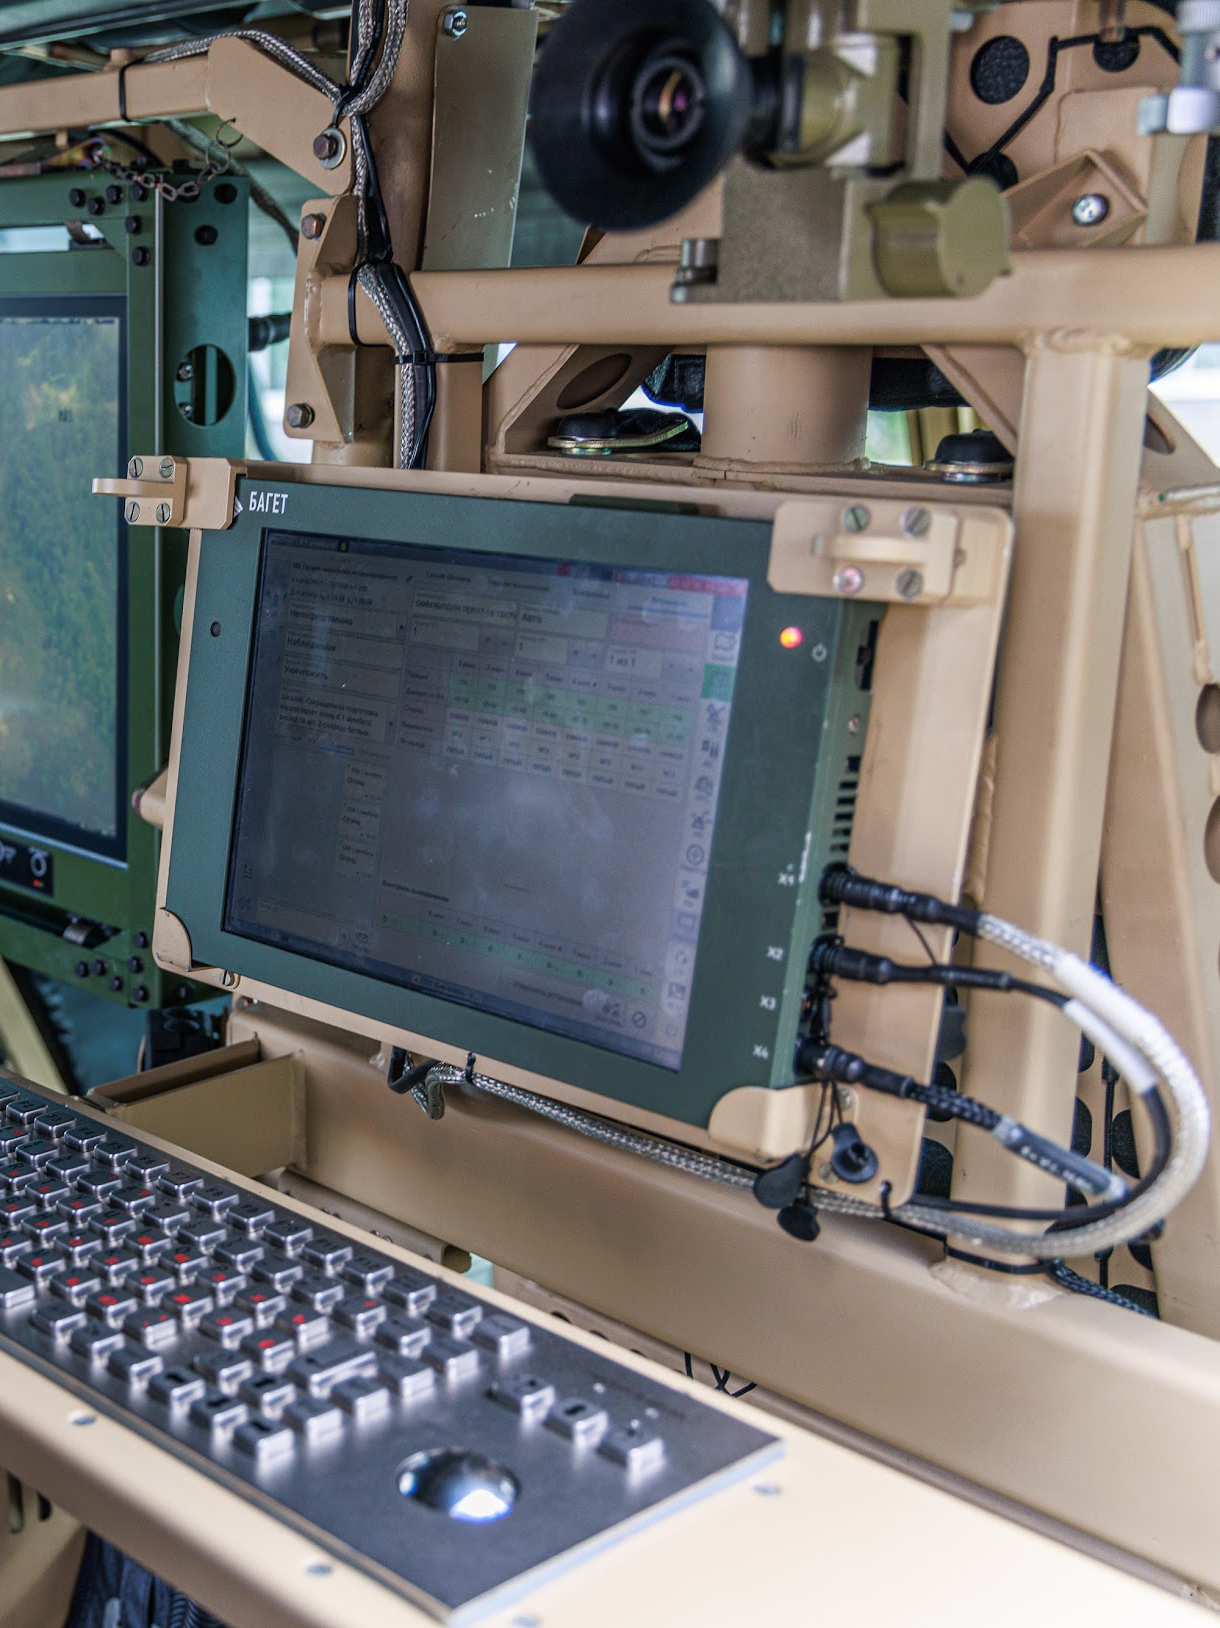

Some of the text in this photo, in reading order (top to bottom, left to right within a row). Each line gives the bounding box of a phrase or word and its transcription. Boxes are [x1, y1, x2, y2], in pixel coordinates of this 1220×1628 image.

[249, 491, 289, 514] БАГЕТ
[289, 608, 353, 626] Непосредственно
[520, 612, 543, 624] Авто
[286, 636, 336, 652] Наблюдаемая
[283, 664, 329, 681] Уничтожить
[778, 872, 794, 886] X1
[767, 945, 784, 961] X2
[760, 995, 777, 1011] X3
[753, 1045, 768, 1059] X4
